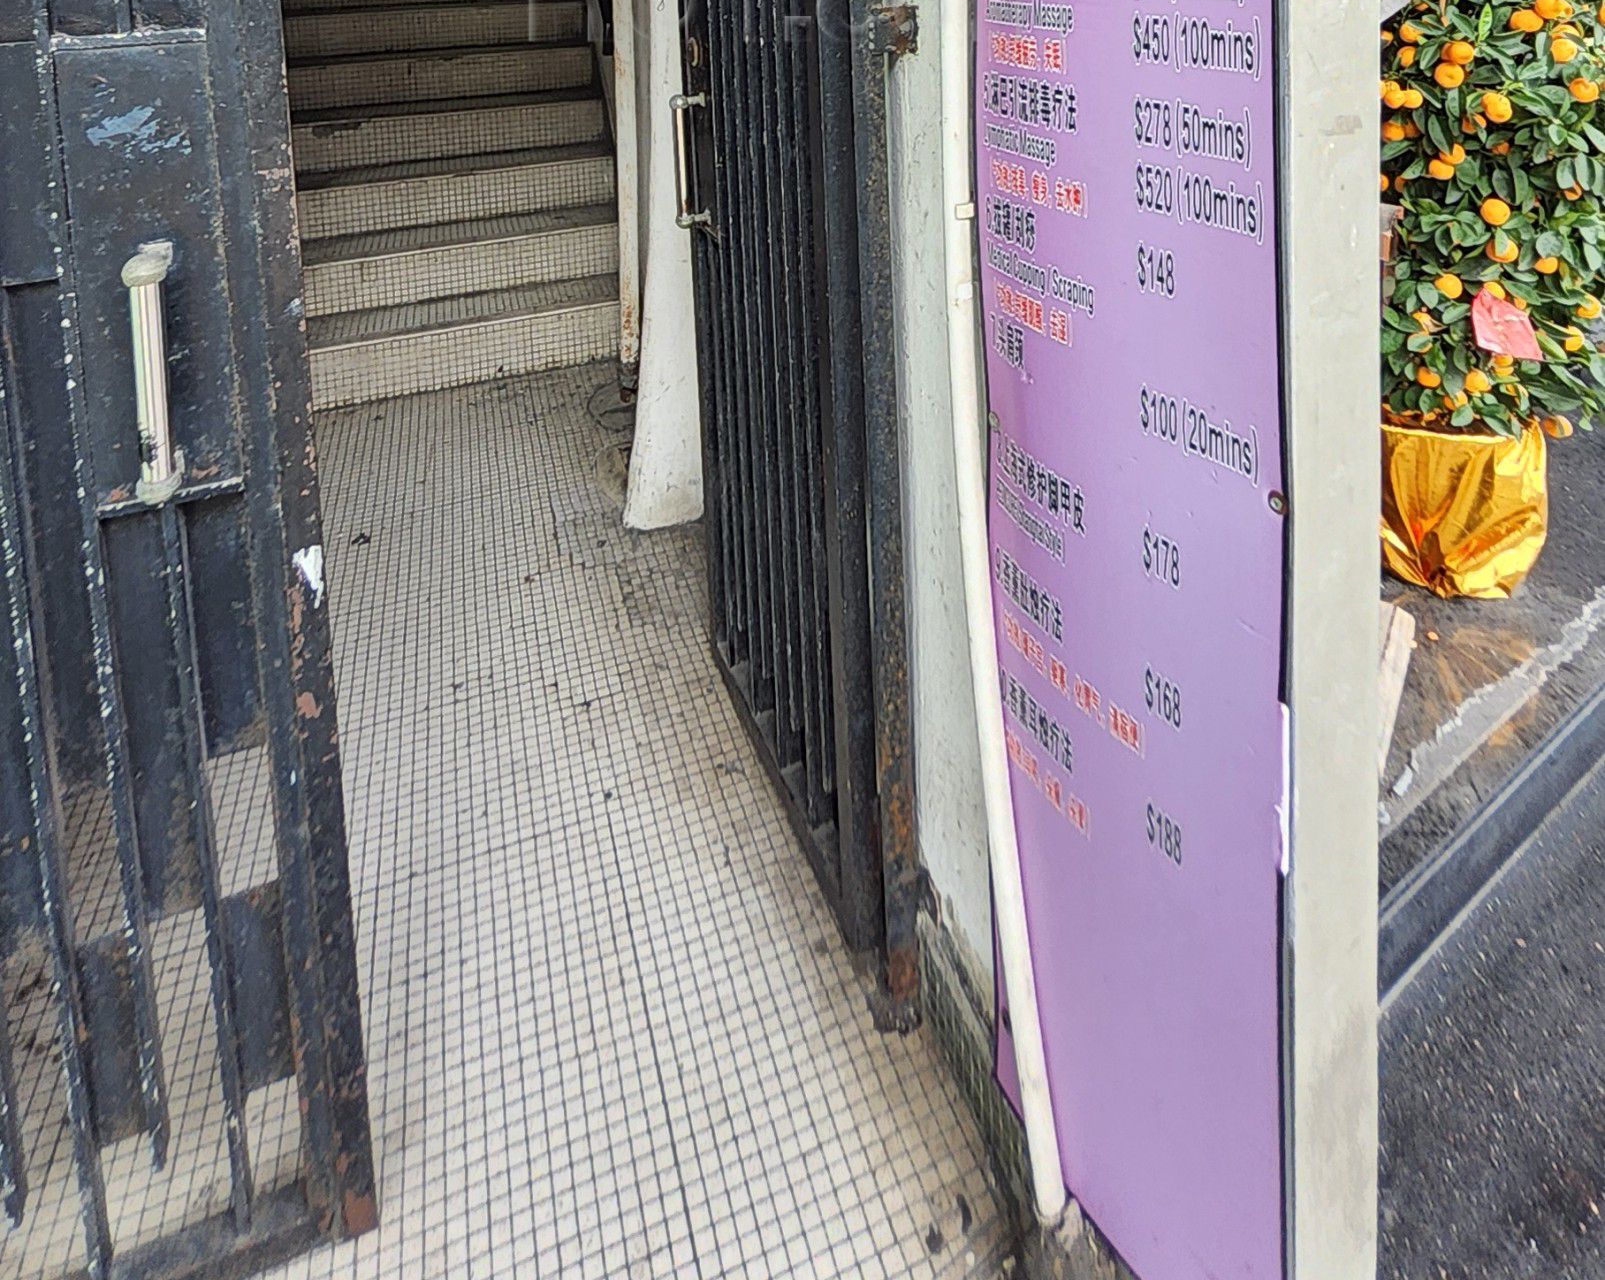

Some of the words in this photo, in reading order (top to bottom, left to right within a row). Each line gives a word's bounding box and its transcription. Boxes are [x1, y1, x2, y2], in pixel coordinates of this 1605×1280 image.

[1132, 10, 1171, 66] $450
[1173, 11, 1261, 81] (100mins)
[1134, 94, 1173, 150] $278
[1175, 98, 1251, 171] (50mins)
[1136, 159, 1174, 212] $520
[1176, 167, 1264, 246] (100mins)
[1052, 265, 1096, 320] Scraping
[1137, 240, 1176, 299] $148
[1140, 382, 1178, 445] $100
[1181, 397, 1259, 488] (20mins)
[1142, 523, 1181, 591] $178
[1144, 662, 1182, 734] $168
[1146, 796, 1183, 871] $188
